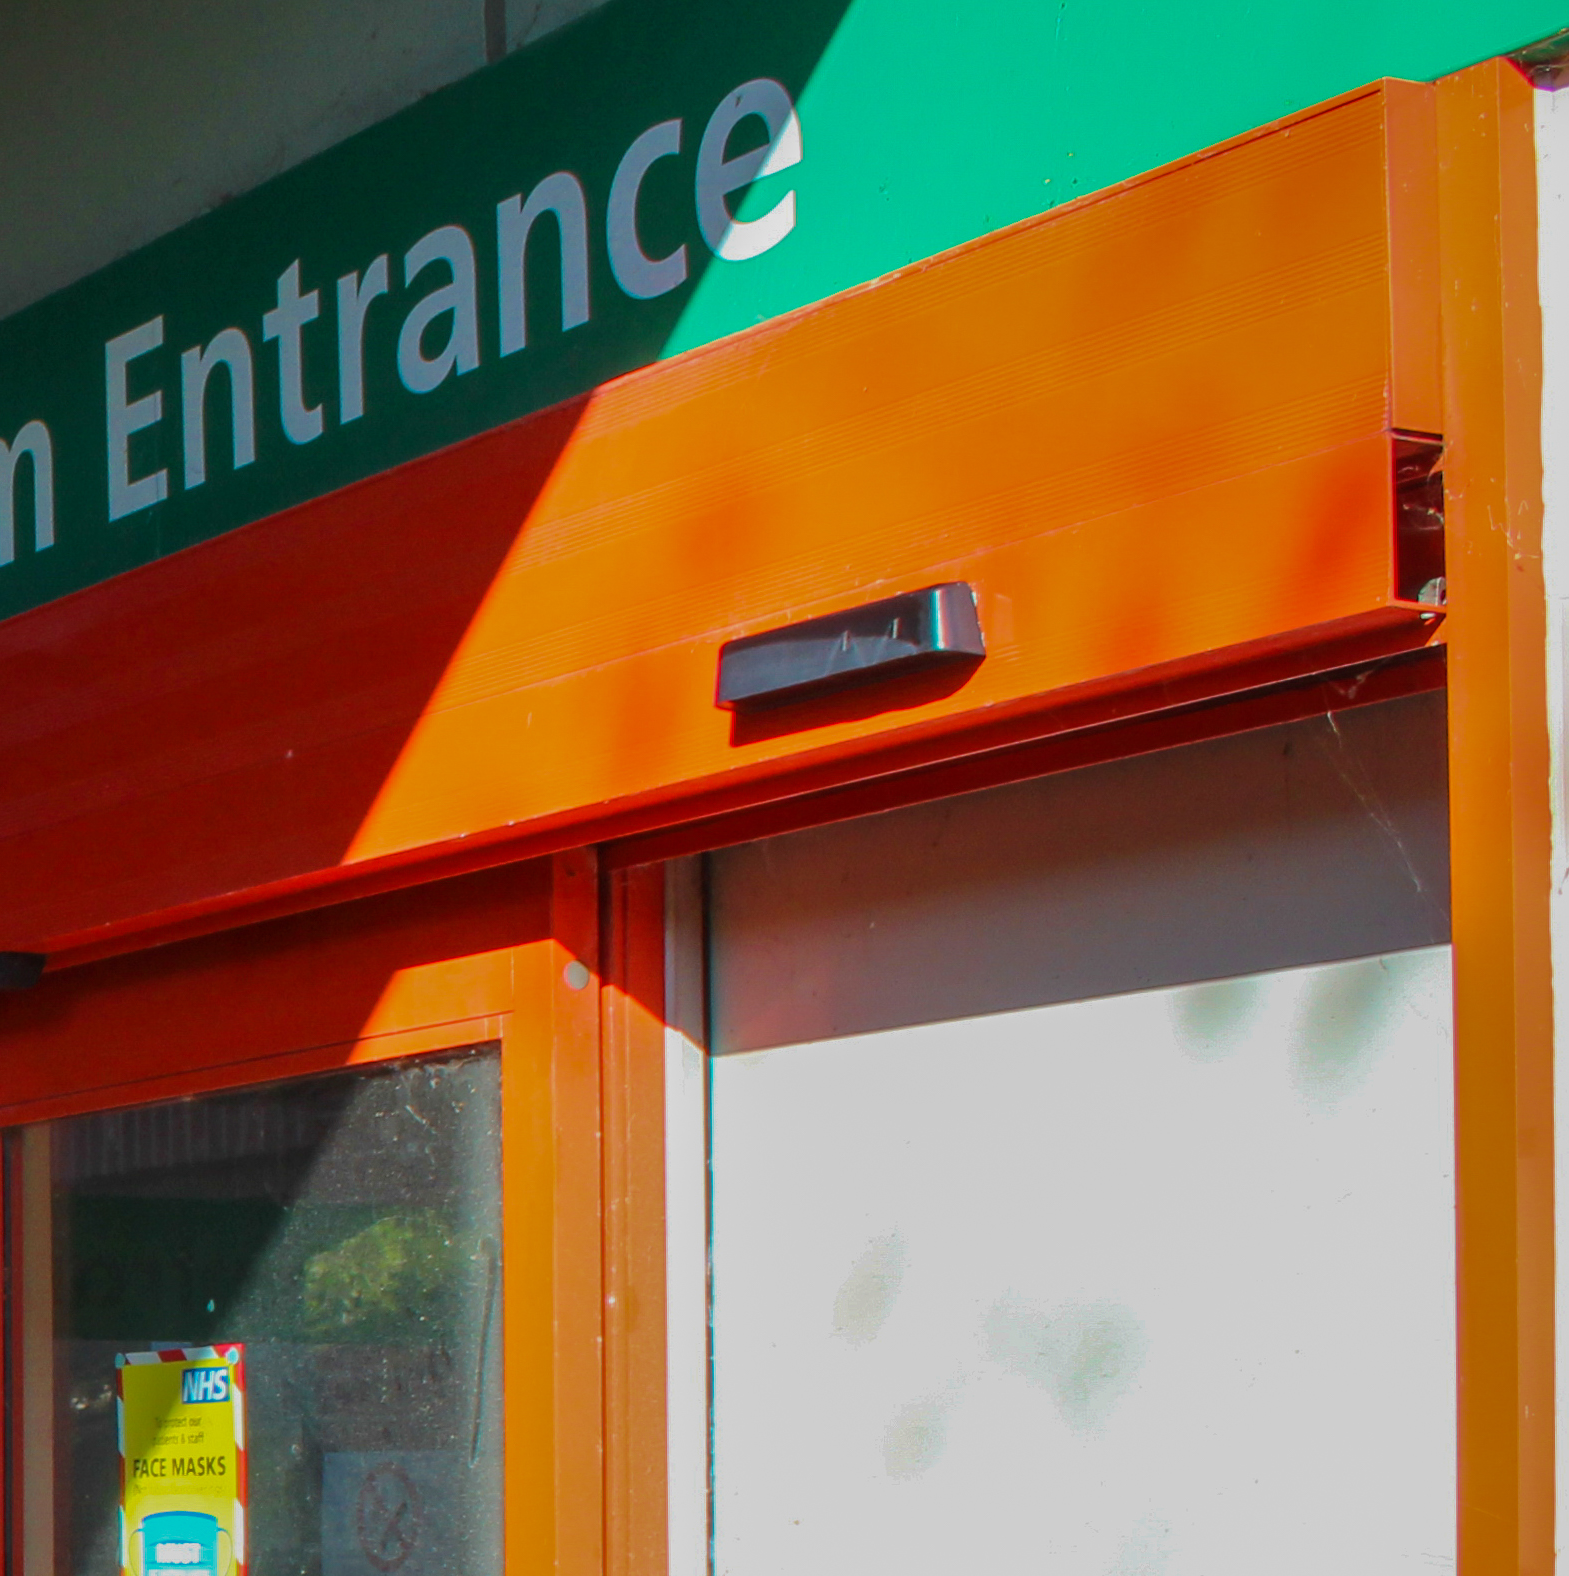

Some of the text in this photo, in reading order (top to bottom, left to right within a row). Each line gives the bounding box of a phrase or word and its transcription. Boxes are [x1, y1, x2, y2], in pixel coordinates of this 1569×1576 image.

[103, 77, 805, 524] Entrance
[183, 1369, 229, 1402] NHS
[188, 1431, 204, 1444] staff
[133, 1456, 226, 1478] FACE MASKS
